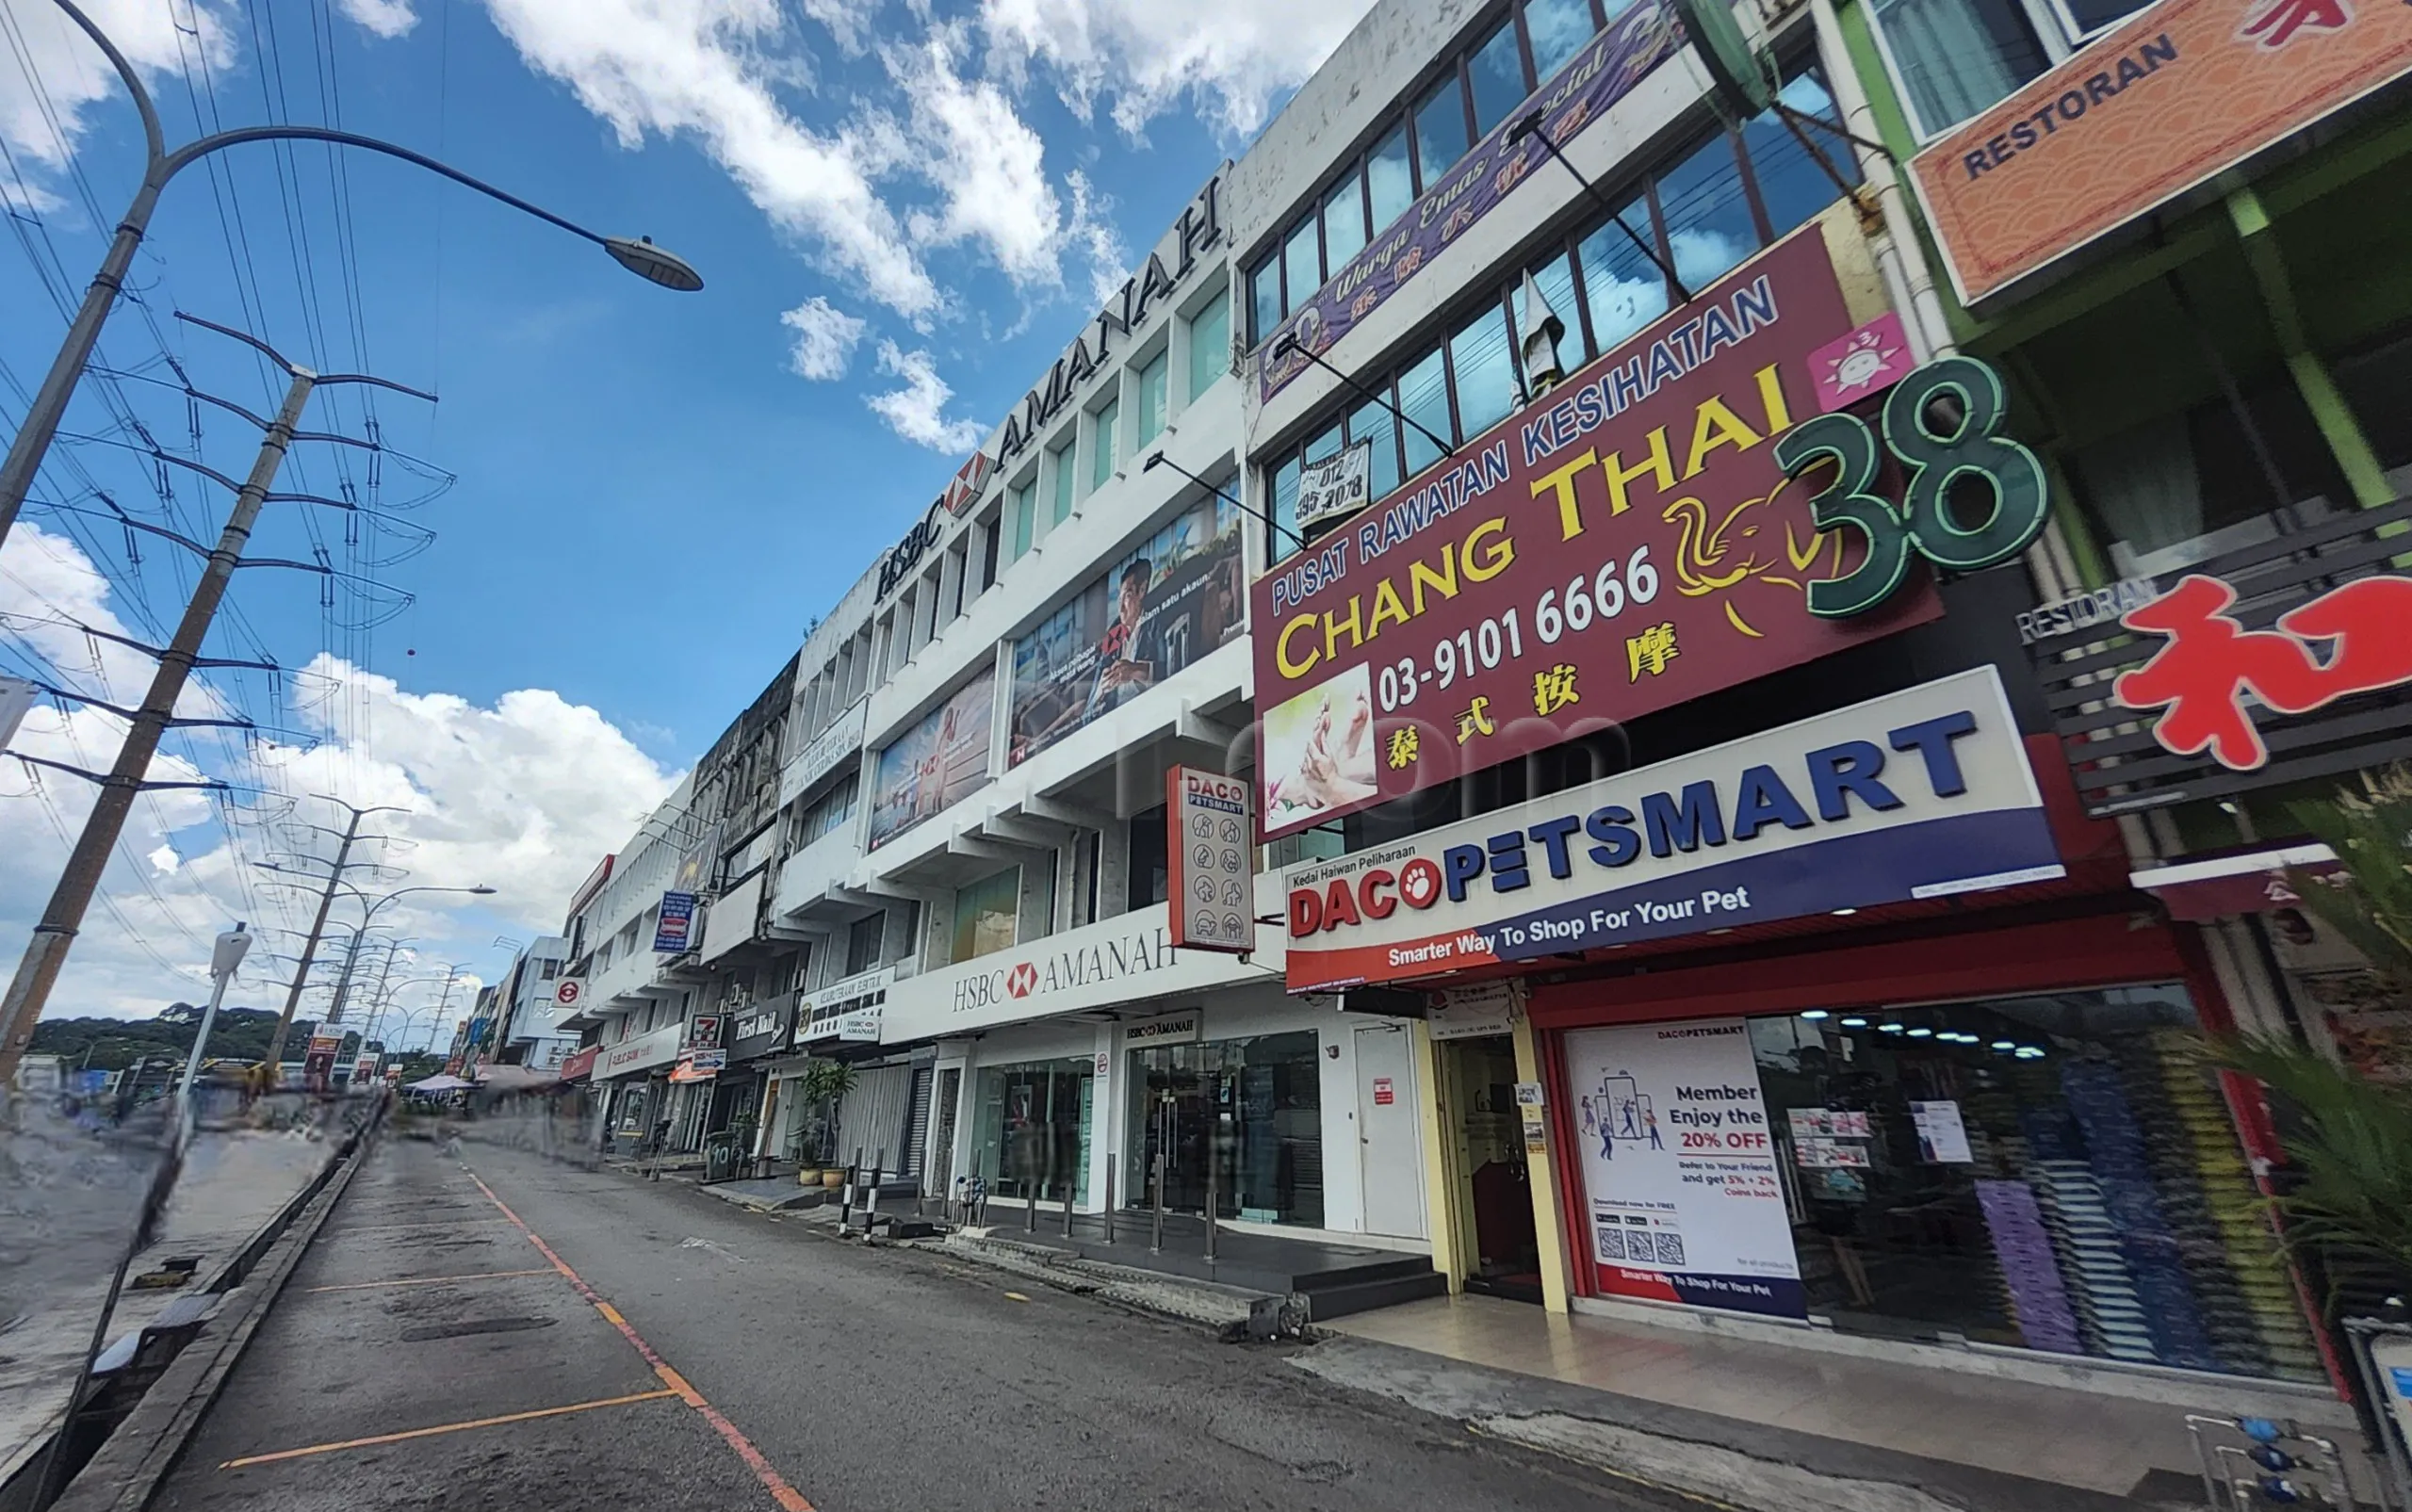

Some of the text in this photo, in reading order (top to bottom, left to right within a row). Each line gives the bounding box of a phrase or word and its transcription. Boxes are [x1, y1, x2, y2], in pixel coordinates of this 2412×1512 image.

[1963, 33, 2178, 181] RESTORAN
[1335, 43, 1607, 303] Warga Emas Secial
[872, 175, 1224, 606] HSBC AMANAH
[1272, 273, 1779, 616] PUSAT RAWATAN KESIHATAN
[1772, 354, 2049, 619] 38
[1274, 363, 1795, 681] CHANG THAI
[1377, 545, 1659, 712] 03-9101 6666
[1384, 621, 1682, 772] 泰式按摩
[1187, 775, 1243, 801] DACO
[1189, 794, 1243, 814] PETSMART
[1294, 845, 1415, 888] Kedai Haiwan Peliharaan
[1389, 885, 1750, 967] Smarter Way To Shop For Your Pet
[952, 968, 1004, 1013] HSBC
[1041, 927, 1179, 995] AMANAH
[697, 1019, 716, 1041] 7
[1156, 1019, 1193, 1035] AMANAH
[1675, 1084, 1757, 1101] Member
[1670, 1108, 1763, 1128] Enjoy the
[1681, 1132, 1768, 1148] 20% OFF
[1682, 1175, 1703, 1183] and
[1706, 1176, 1725, 1185] get
[1718, 1162, 1738, 1171] Your
[1741, 1162, 1773, 1172] Friend
[1621, 1269, 1653, 1282] Smarter
[1654, 1273, 1672, 1285] Way
[1674, 1275, 1686, 1285] To
[1687, 1276, 1711, 1291] Shop
[1712, 1279, 1728, 1291] For
[1729, 1282, 1753, 1293] Your
